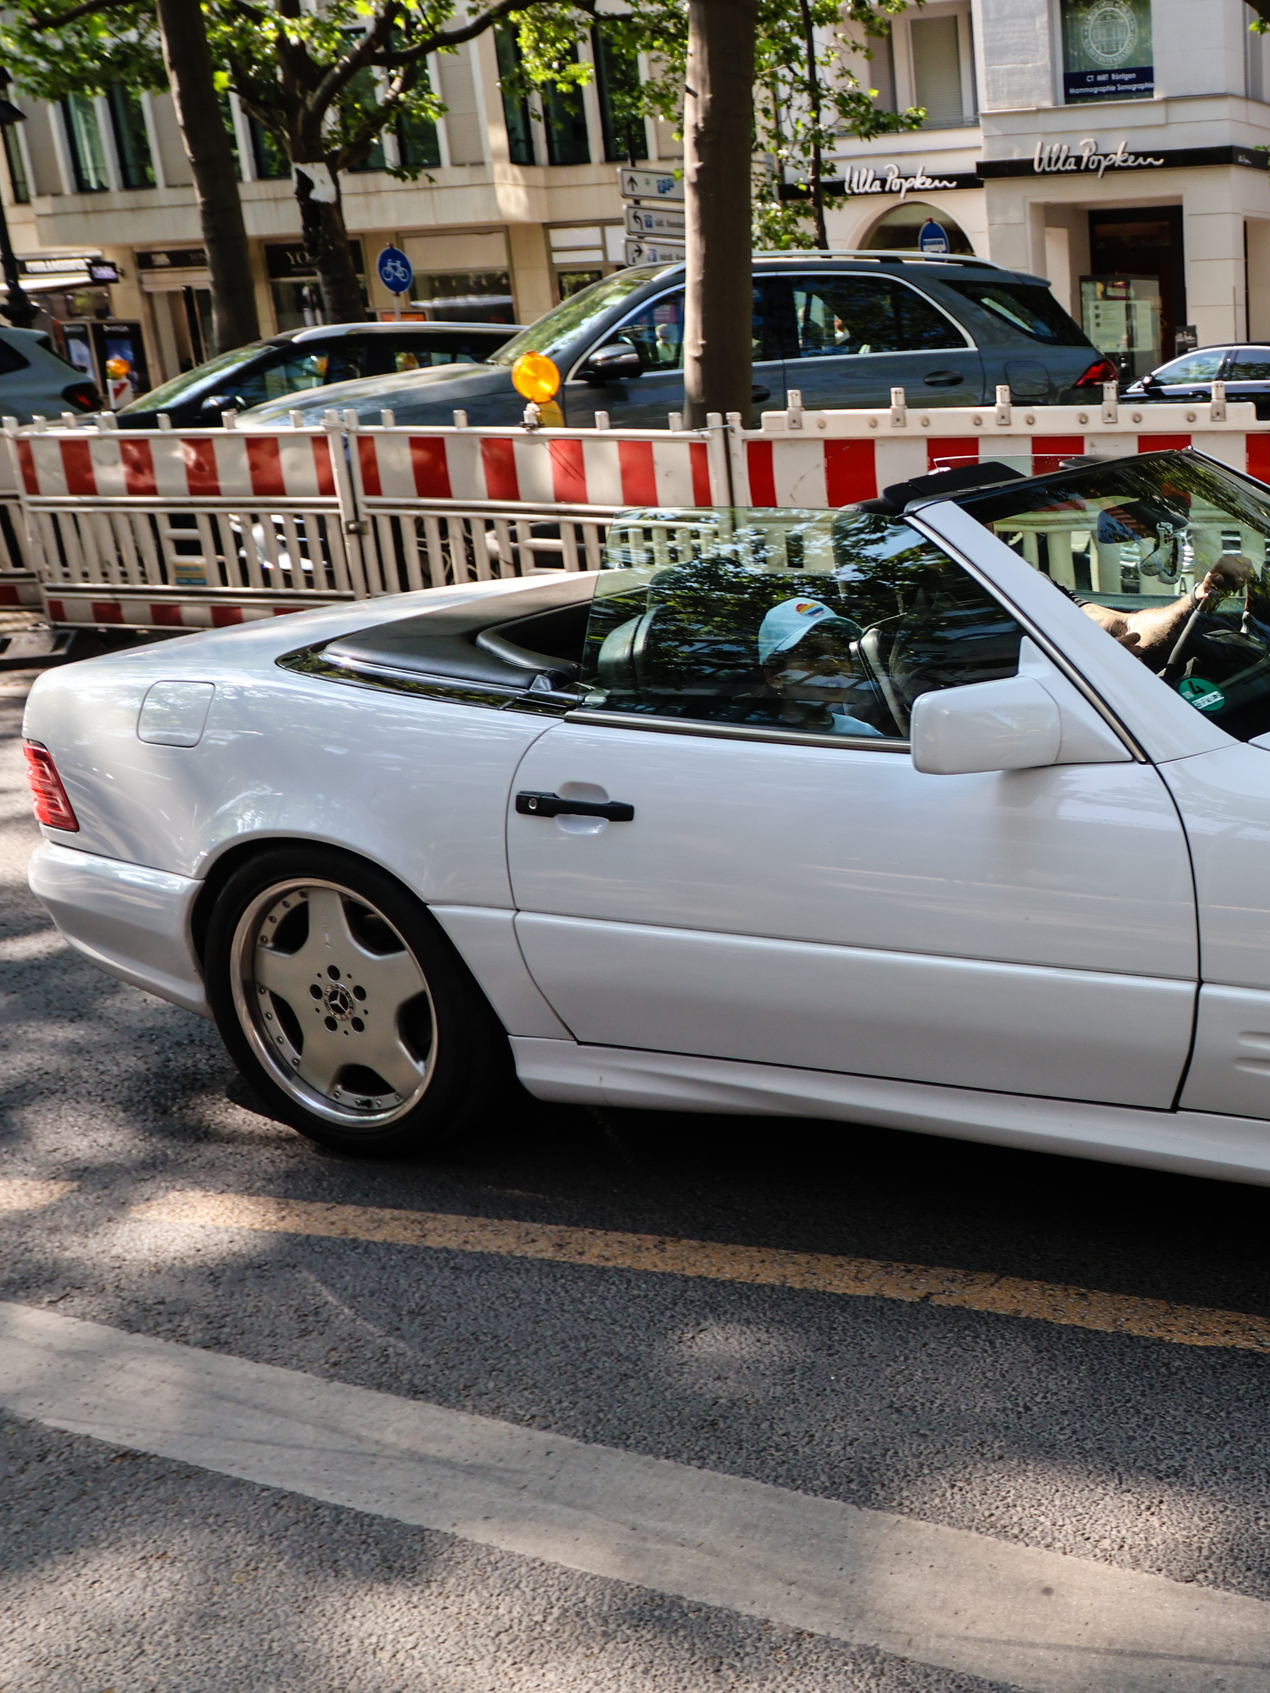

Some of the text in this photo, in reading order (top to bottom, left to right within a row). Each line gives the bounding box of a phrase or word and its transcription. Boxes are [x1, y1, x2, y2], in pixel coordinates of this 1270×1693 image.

[1111, 73, 1137, 81] Röntgen
[1069, 84, 1116, 95] Mammographie
[1034, 138, 1164, 178] Ulla Popken
[844, 164, 958, 199] Ulla Popken
[1187, 680, 1206, 695] 4
